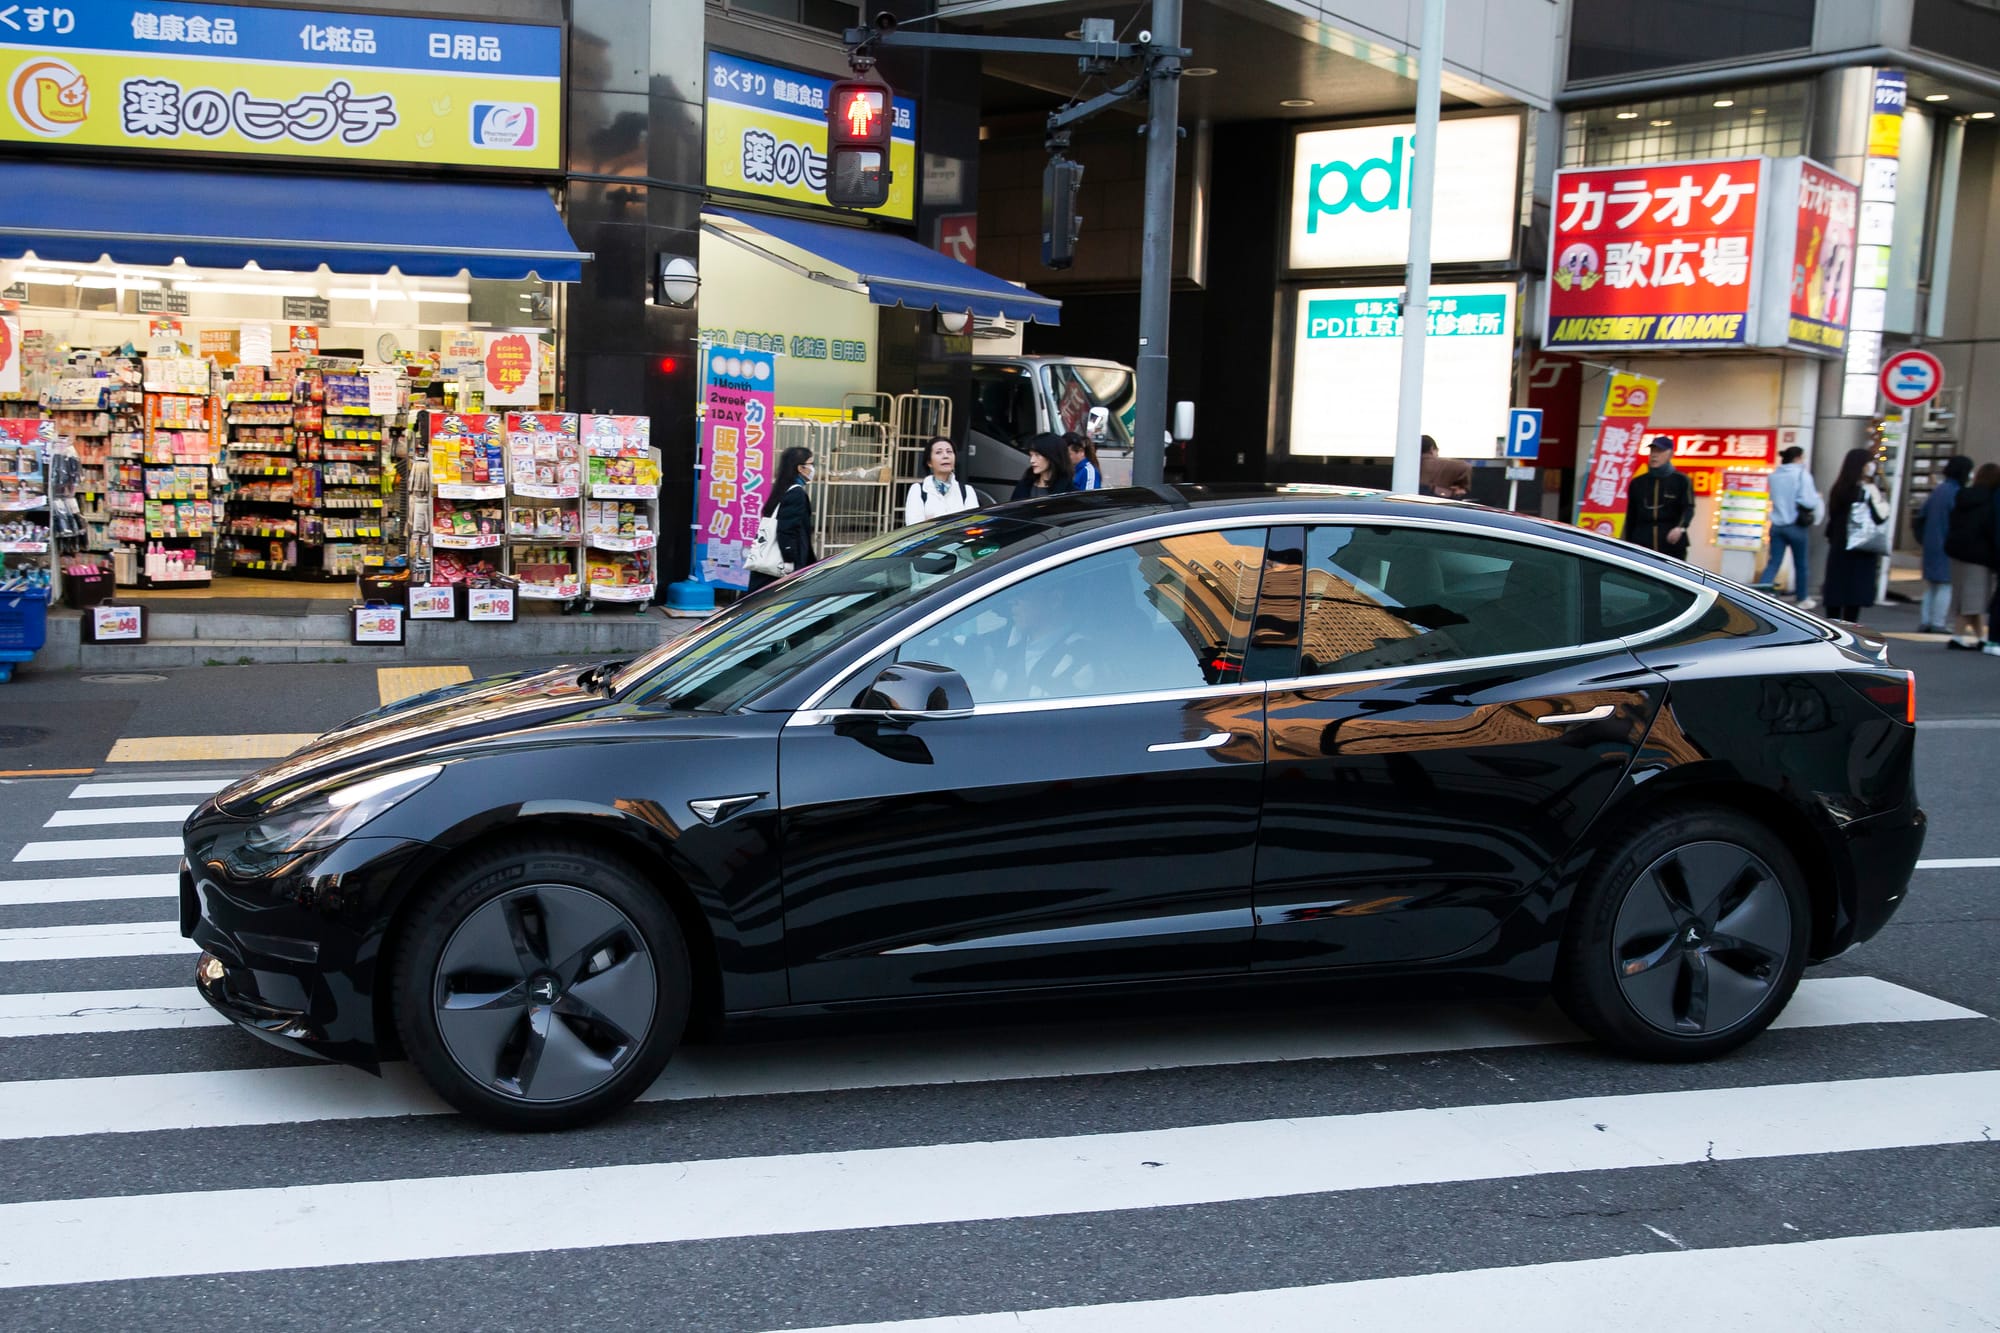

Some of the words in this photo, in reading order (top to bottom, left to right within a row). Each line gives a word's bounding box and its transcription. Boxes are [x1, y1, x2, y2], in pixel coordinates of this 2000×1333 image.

[0, 4, 76, 34] くすり
[131, 11, 238, 46] 健康食品
[299, 25, 377, 55] 化粧品
[428, 33, 502, 63] 日用品
[713, 65, 766, 96] おくすり
[773, 78, 824, 109] 健康食品
[122, 79, 396, 143] 薬のヒグチ
[743, 131, 828, 191] 薬のヒ
[1559, 173, 1755, 232] カラオケ
[1604, 237, 1749, 289] 歌広場
[1354, 299, 1459, 316] 明海大学部
[1552, 315, 1656, 341] AMUSEMENT
[1654, 314, 1743, 340] KARAOKE
[791, 336, 827, 359] 化粧品
[831, 341, 867, 362] 日用品
[713, 378, 752, 392] 1Month
[710, 392, 747, 407] 2week
[711, 409, 742, 422] 1DAY
[1513, 413, 1537, 454] P
[1588, 426, 1630, 507] 歌広場
[431, 597, 450, 611] 168
[491, 600, 510, 613] 198
[378, 618, 396, 632] 88
